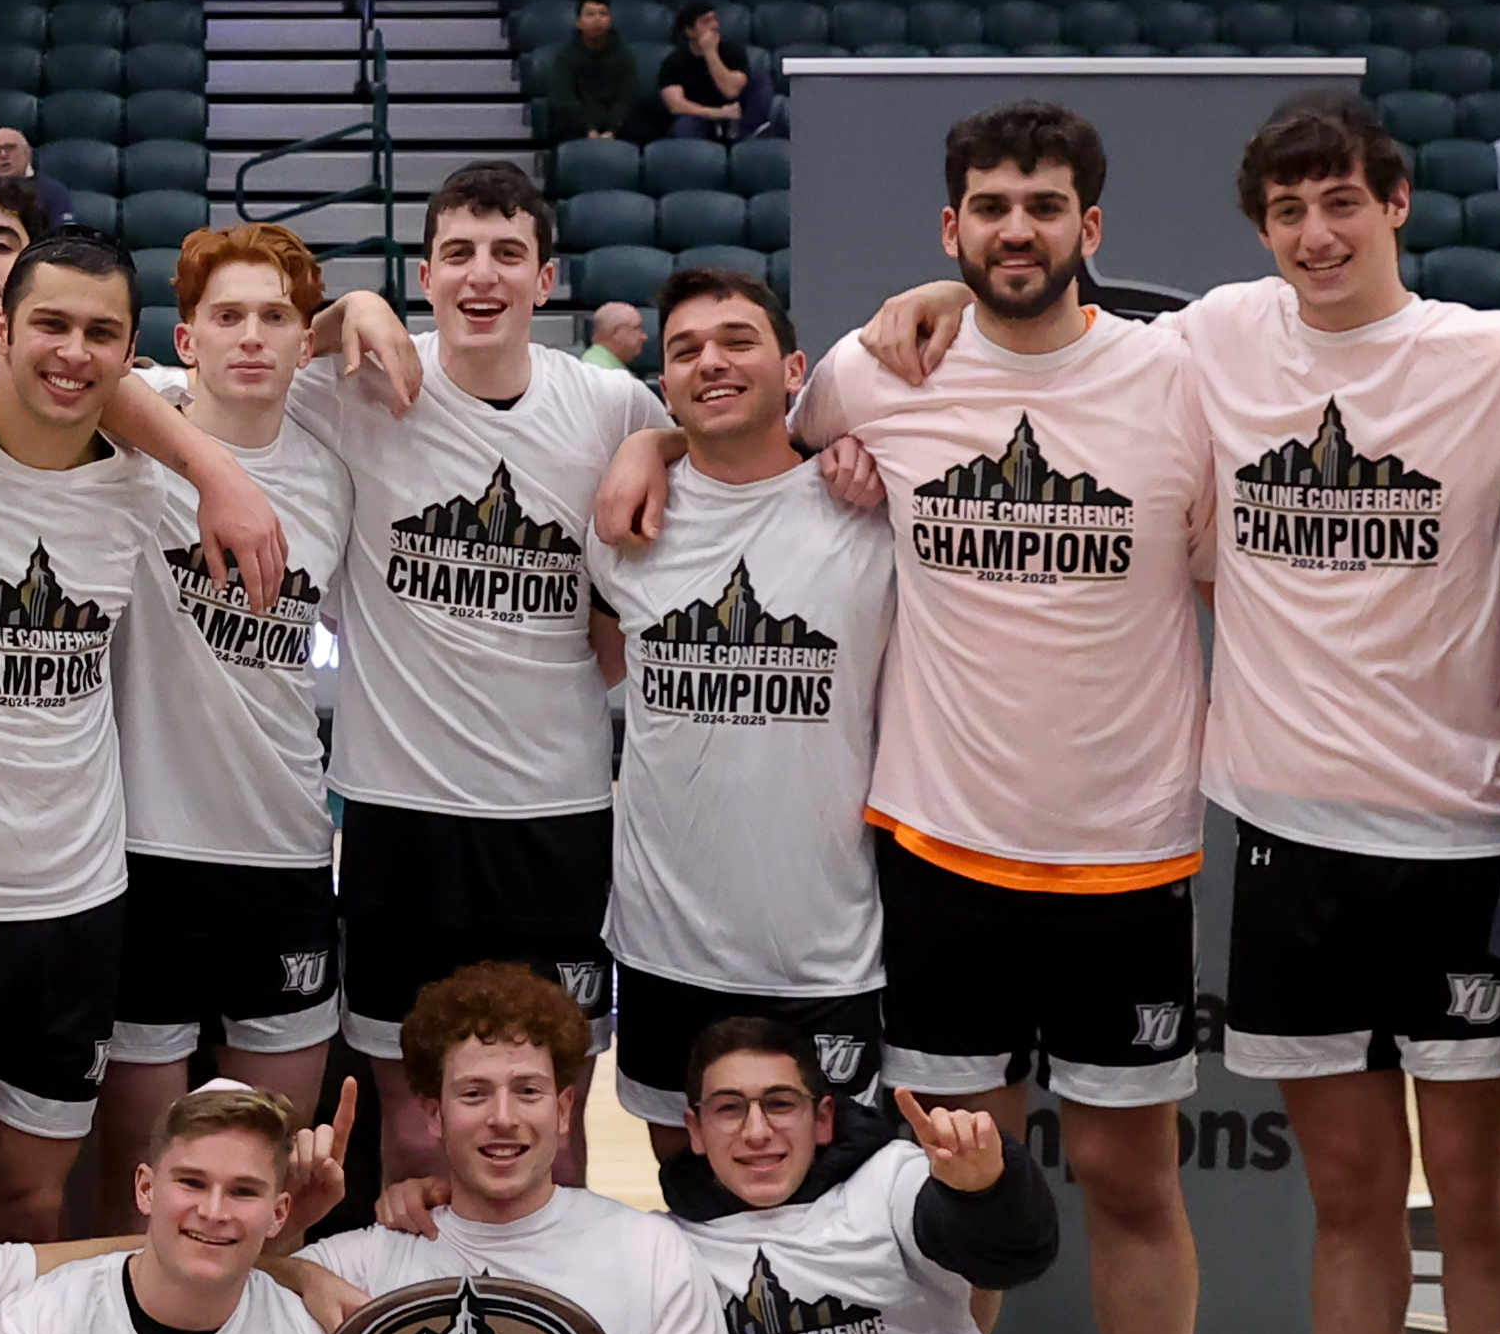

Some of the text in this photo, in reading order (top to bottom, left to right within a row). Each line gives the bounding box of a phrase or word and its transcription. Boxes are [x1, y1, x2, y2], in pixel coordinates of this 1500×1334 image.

[912, 494, 1135, 527] SKYLINE CONFERENCE
[1235, 478, 1443, 511] SKYLINE CONFERENCE
[390, 528, 470, 560] SKYLINE
[913, 523, 1134, 574] CHAMPIONS
[1233, 506, 1441, 561] CHAMPIONS
[976, 569, 1058, 585] 2024-2025
[1291, 556, 1367, 572] 2024-2025
[386, 554, 579, 613] CHAMPIONS
[449, 605, 525, 623] 2024-2025
[180, 597, 312, 666] AMPIONS
[213, 649, 267, 670] 24-2025
[639, 639, 839, 668] SKYLINE CONFERENCE
[0, 697, 67, 709] 2024-2025
[642, 665, 833, 717] CHAMPIONS
[692, 712, 767, 726] 2024-2025
[280, 948, 329, 996] YU
[556, 961, 605, 1008] YU
[1131, 1001, 1185, 1052] YU
[813, 1033, 866, 1084] YU
